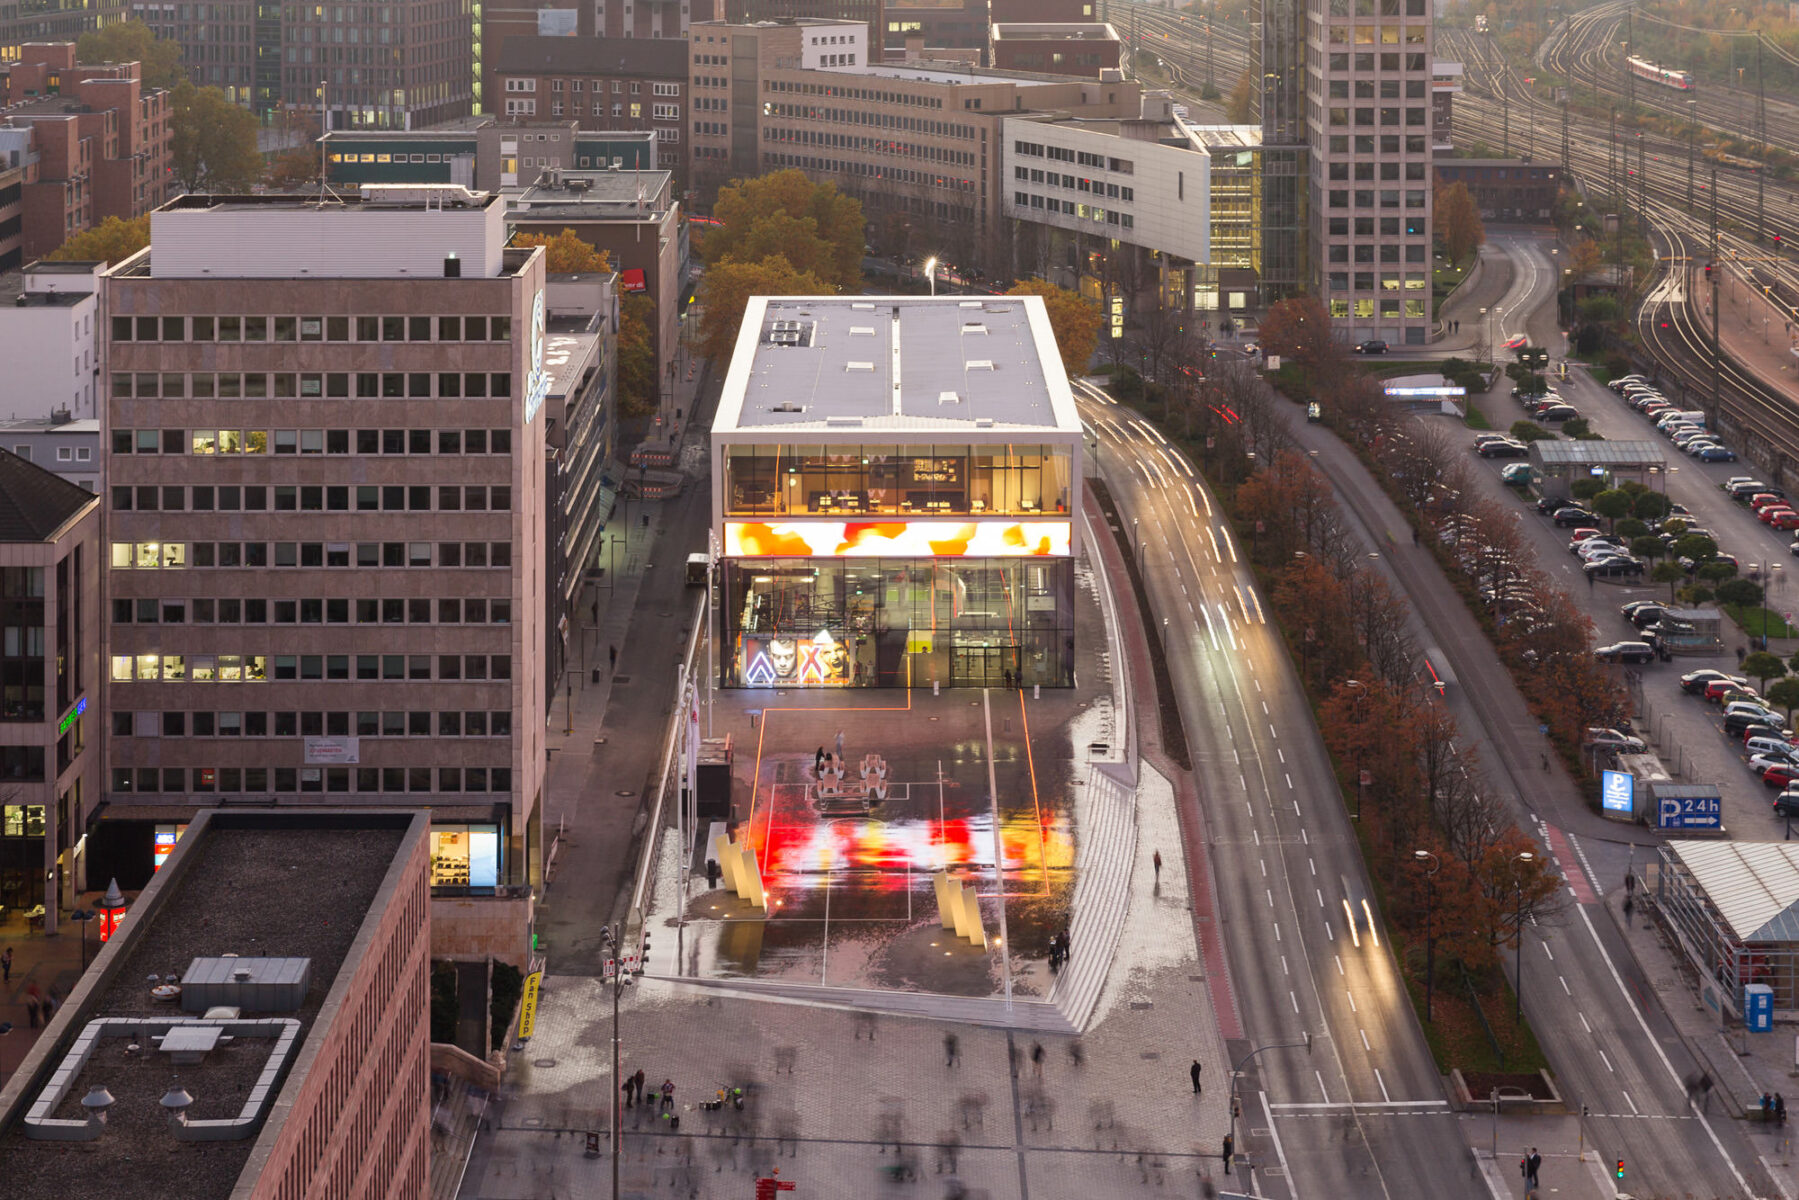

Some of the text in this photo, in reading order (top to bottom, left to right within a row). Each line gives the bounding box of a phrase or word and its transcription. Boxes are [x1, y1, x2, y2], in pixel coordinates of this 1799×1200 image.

[1660, 799, 1682, 827] P
[523, 976, 537, 1035] Fan Shop
